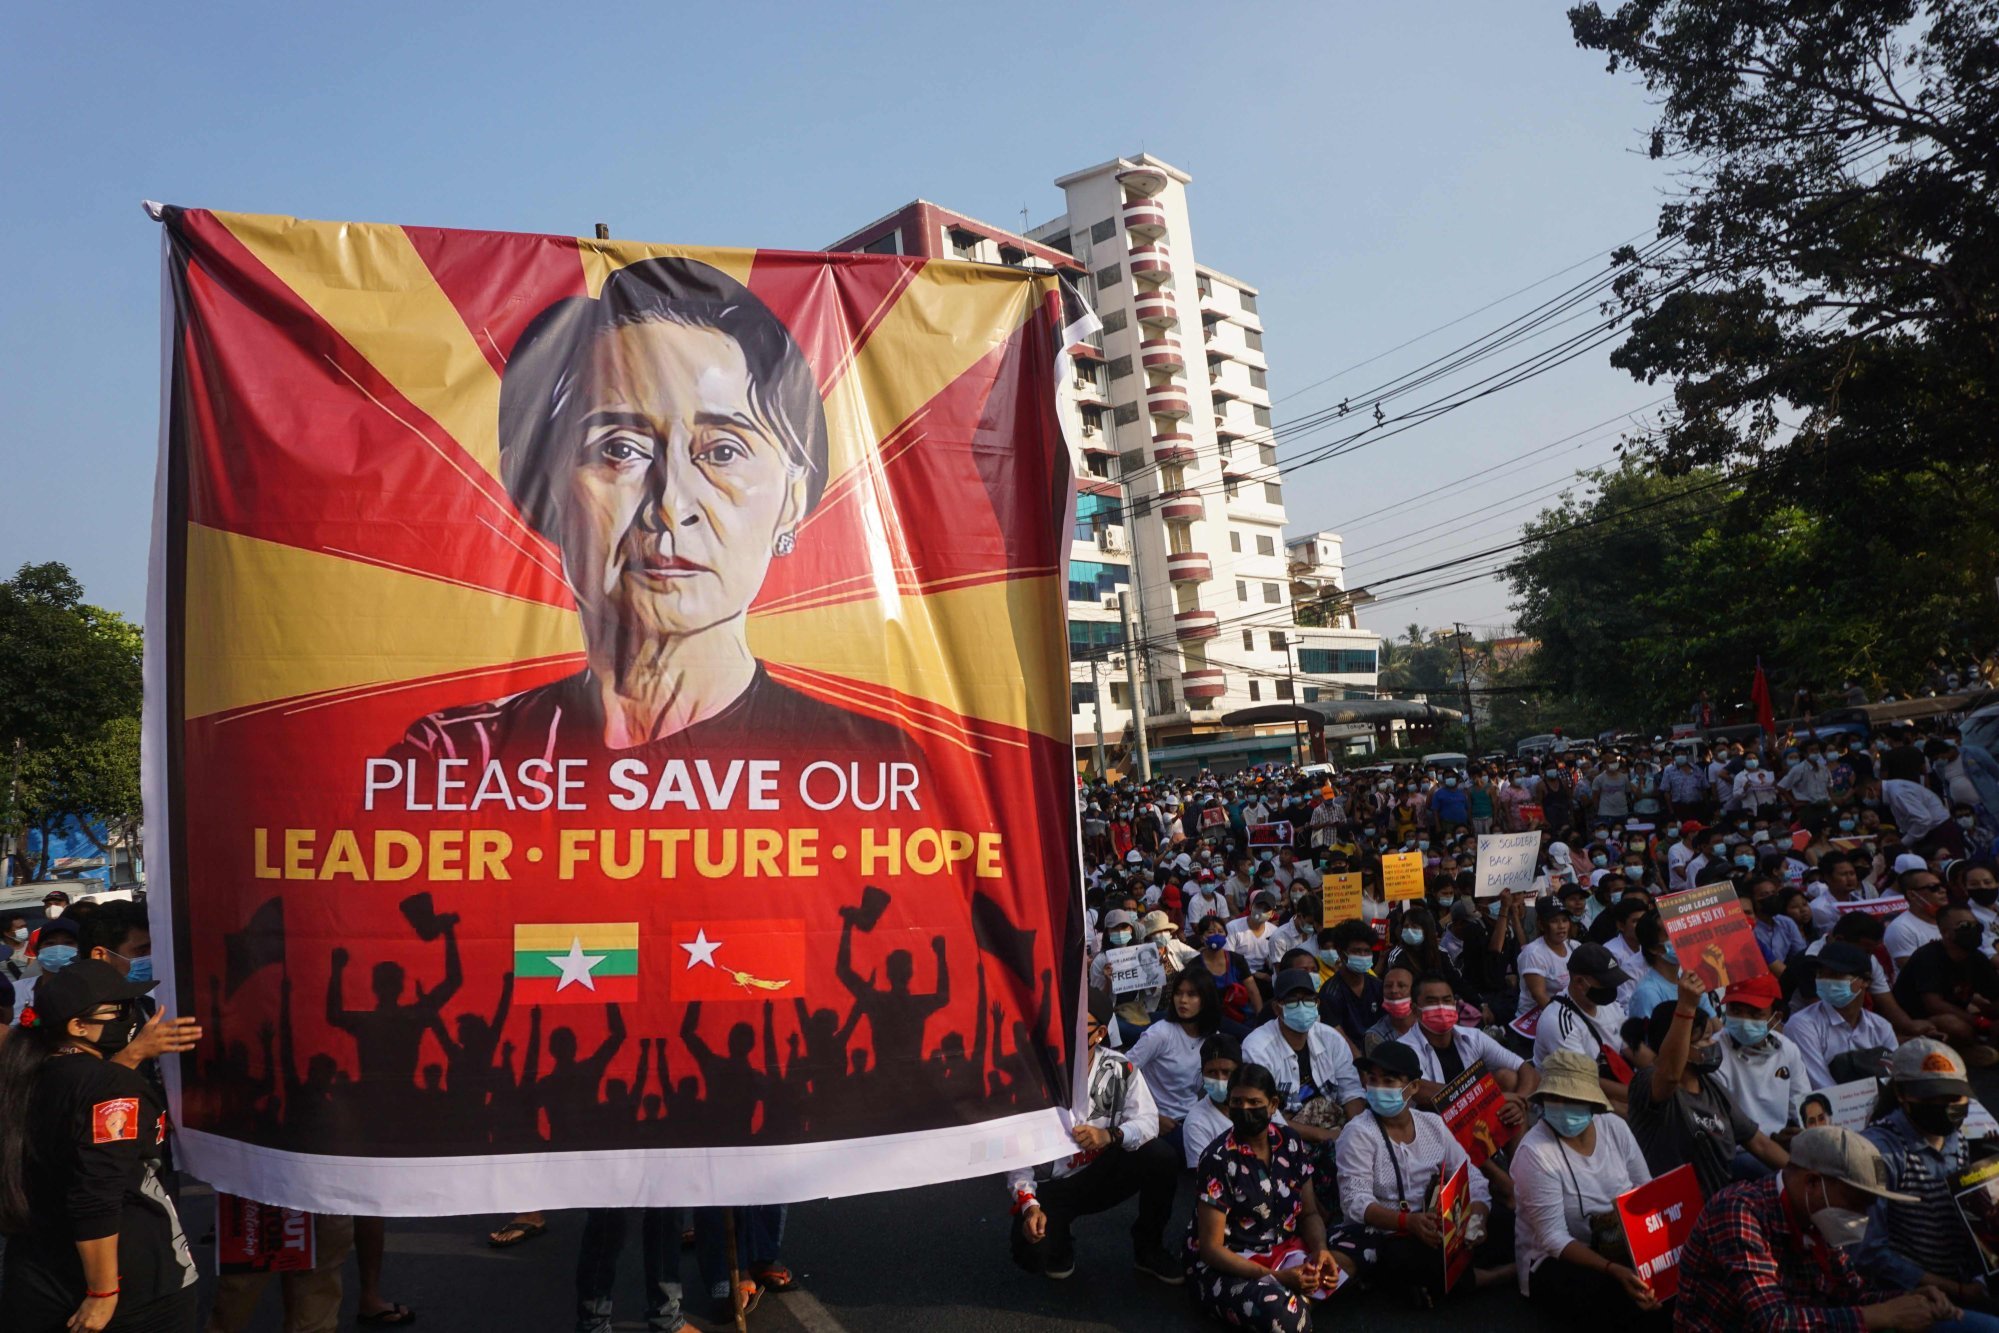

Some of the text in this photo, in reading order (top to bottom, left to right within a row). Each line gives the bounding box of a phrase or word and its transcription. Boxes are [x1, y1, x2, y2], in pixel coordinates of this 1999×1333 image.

[365, 758, 921, 811] PLEASE SAVE OUR
[254, 827, 1004, 881] LEADER FUTURE HOPE
[1498, 836, 1538, 849] SOLDIERS
[1489, 853, 1530, 867] BACK TO
[1678, 896, 1719, 914] OUR LEADER
[1666, 917, 1688, 933] AUNG
[1686, 912, 1703, 928] SAN
[1701, 909, 1714, 924] SU
[1712, 906, 1726, 920] KYI
[1112, 968, 1139, 982] FREE
[1448, 1075, 1477, 1102] OUR LEADER
[1443, 1106, 1459, 1123] AUNG
[1456, 1098, 1468, 1111] SAN
[1466, 1091, 1475, 1103] SU
[1473, 1083, 1484, 1096] KYI
[1645, 1211, 1664, 1234] SAY
[1638, 1262, 1652, 1281] TO
